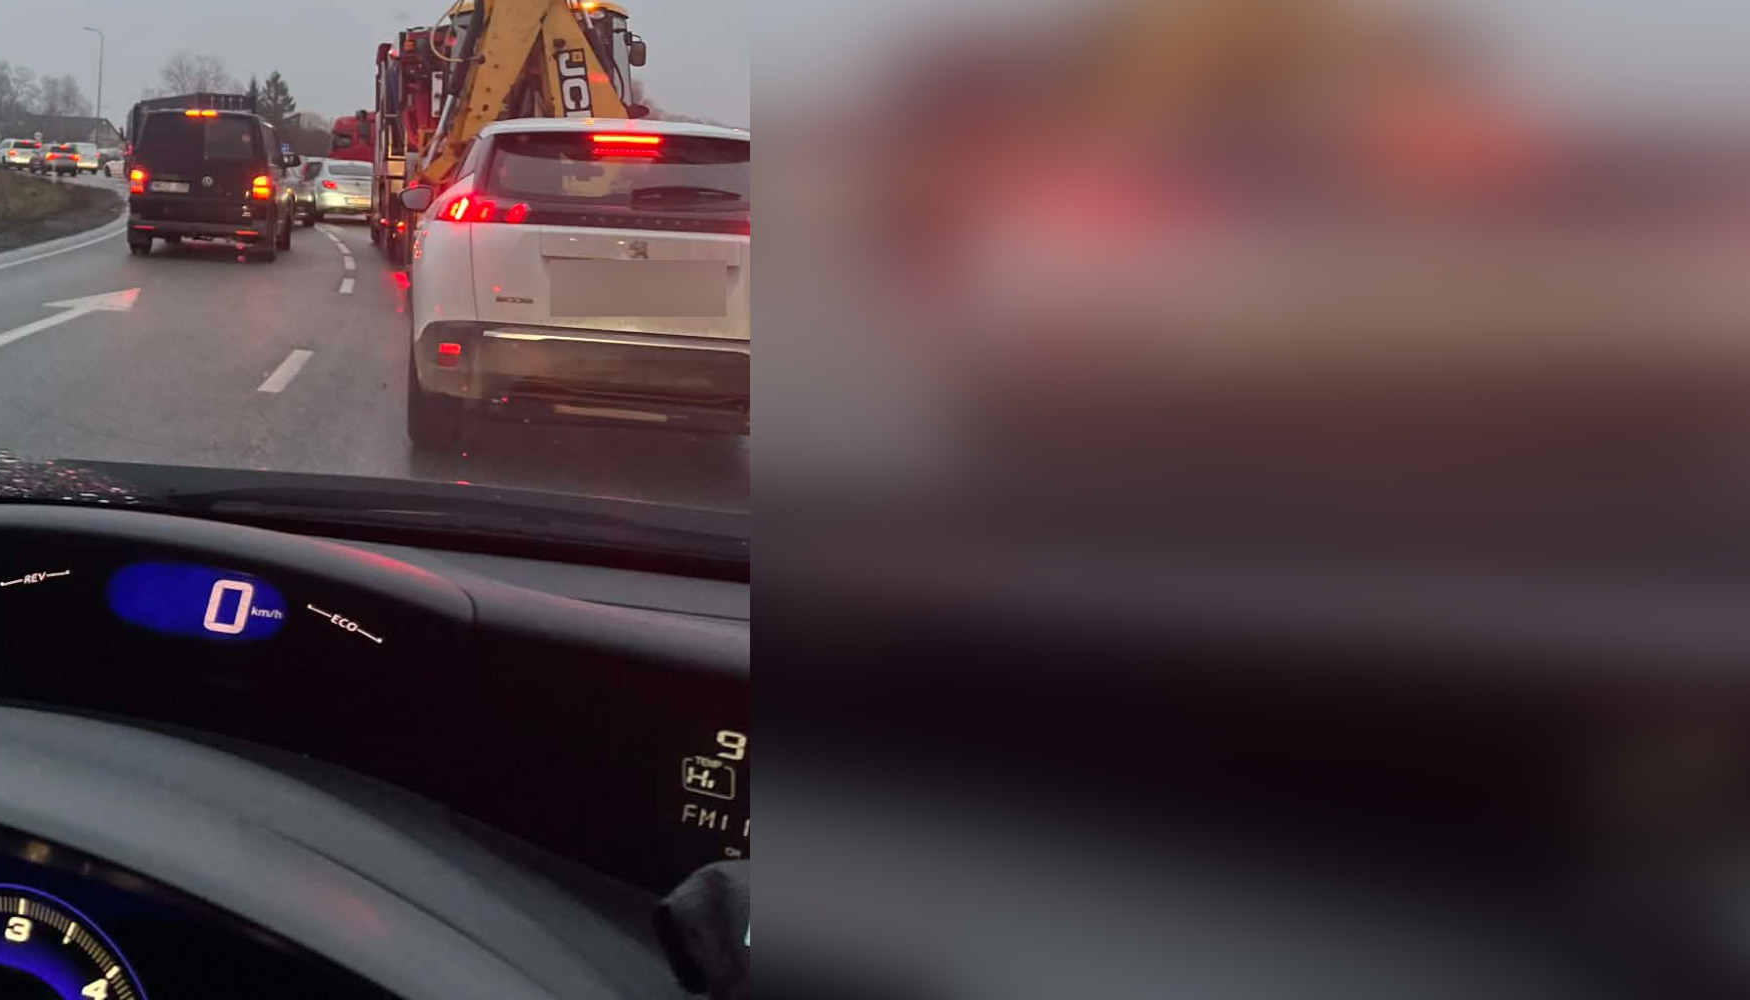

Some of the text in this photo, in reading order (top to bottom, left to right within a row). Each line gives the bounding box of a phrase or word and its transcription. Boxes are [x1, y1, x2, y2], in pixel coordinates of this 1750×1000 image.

[558, 52, 591, 117] JC
[24, 571, 47, 584] REV
[203, 579, 283, 635] 0 km/h
[330, 613, 358, 632] ECO
[4, 916, 32, 942] 3
[81, 978, 109, 1000] 4
